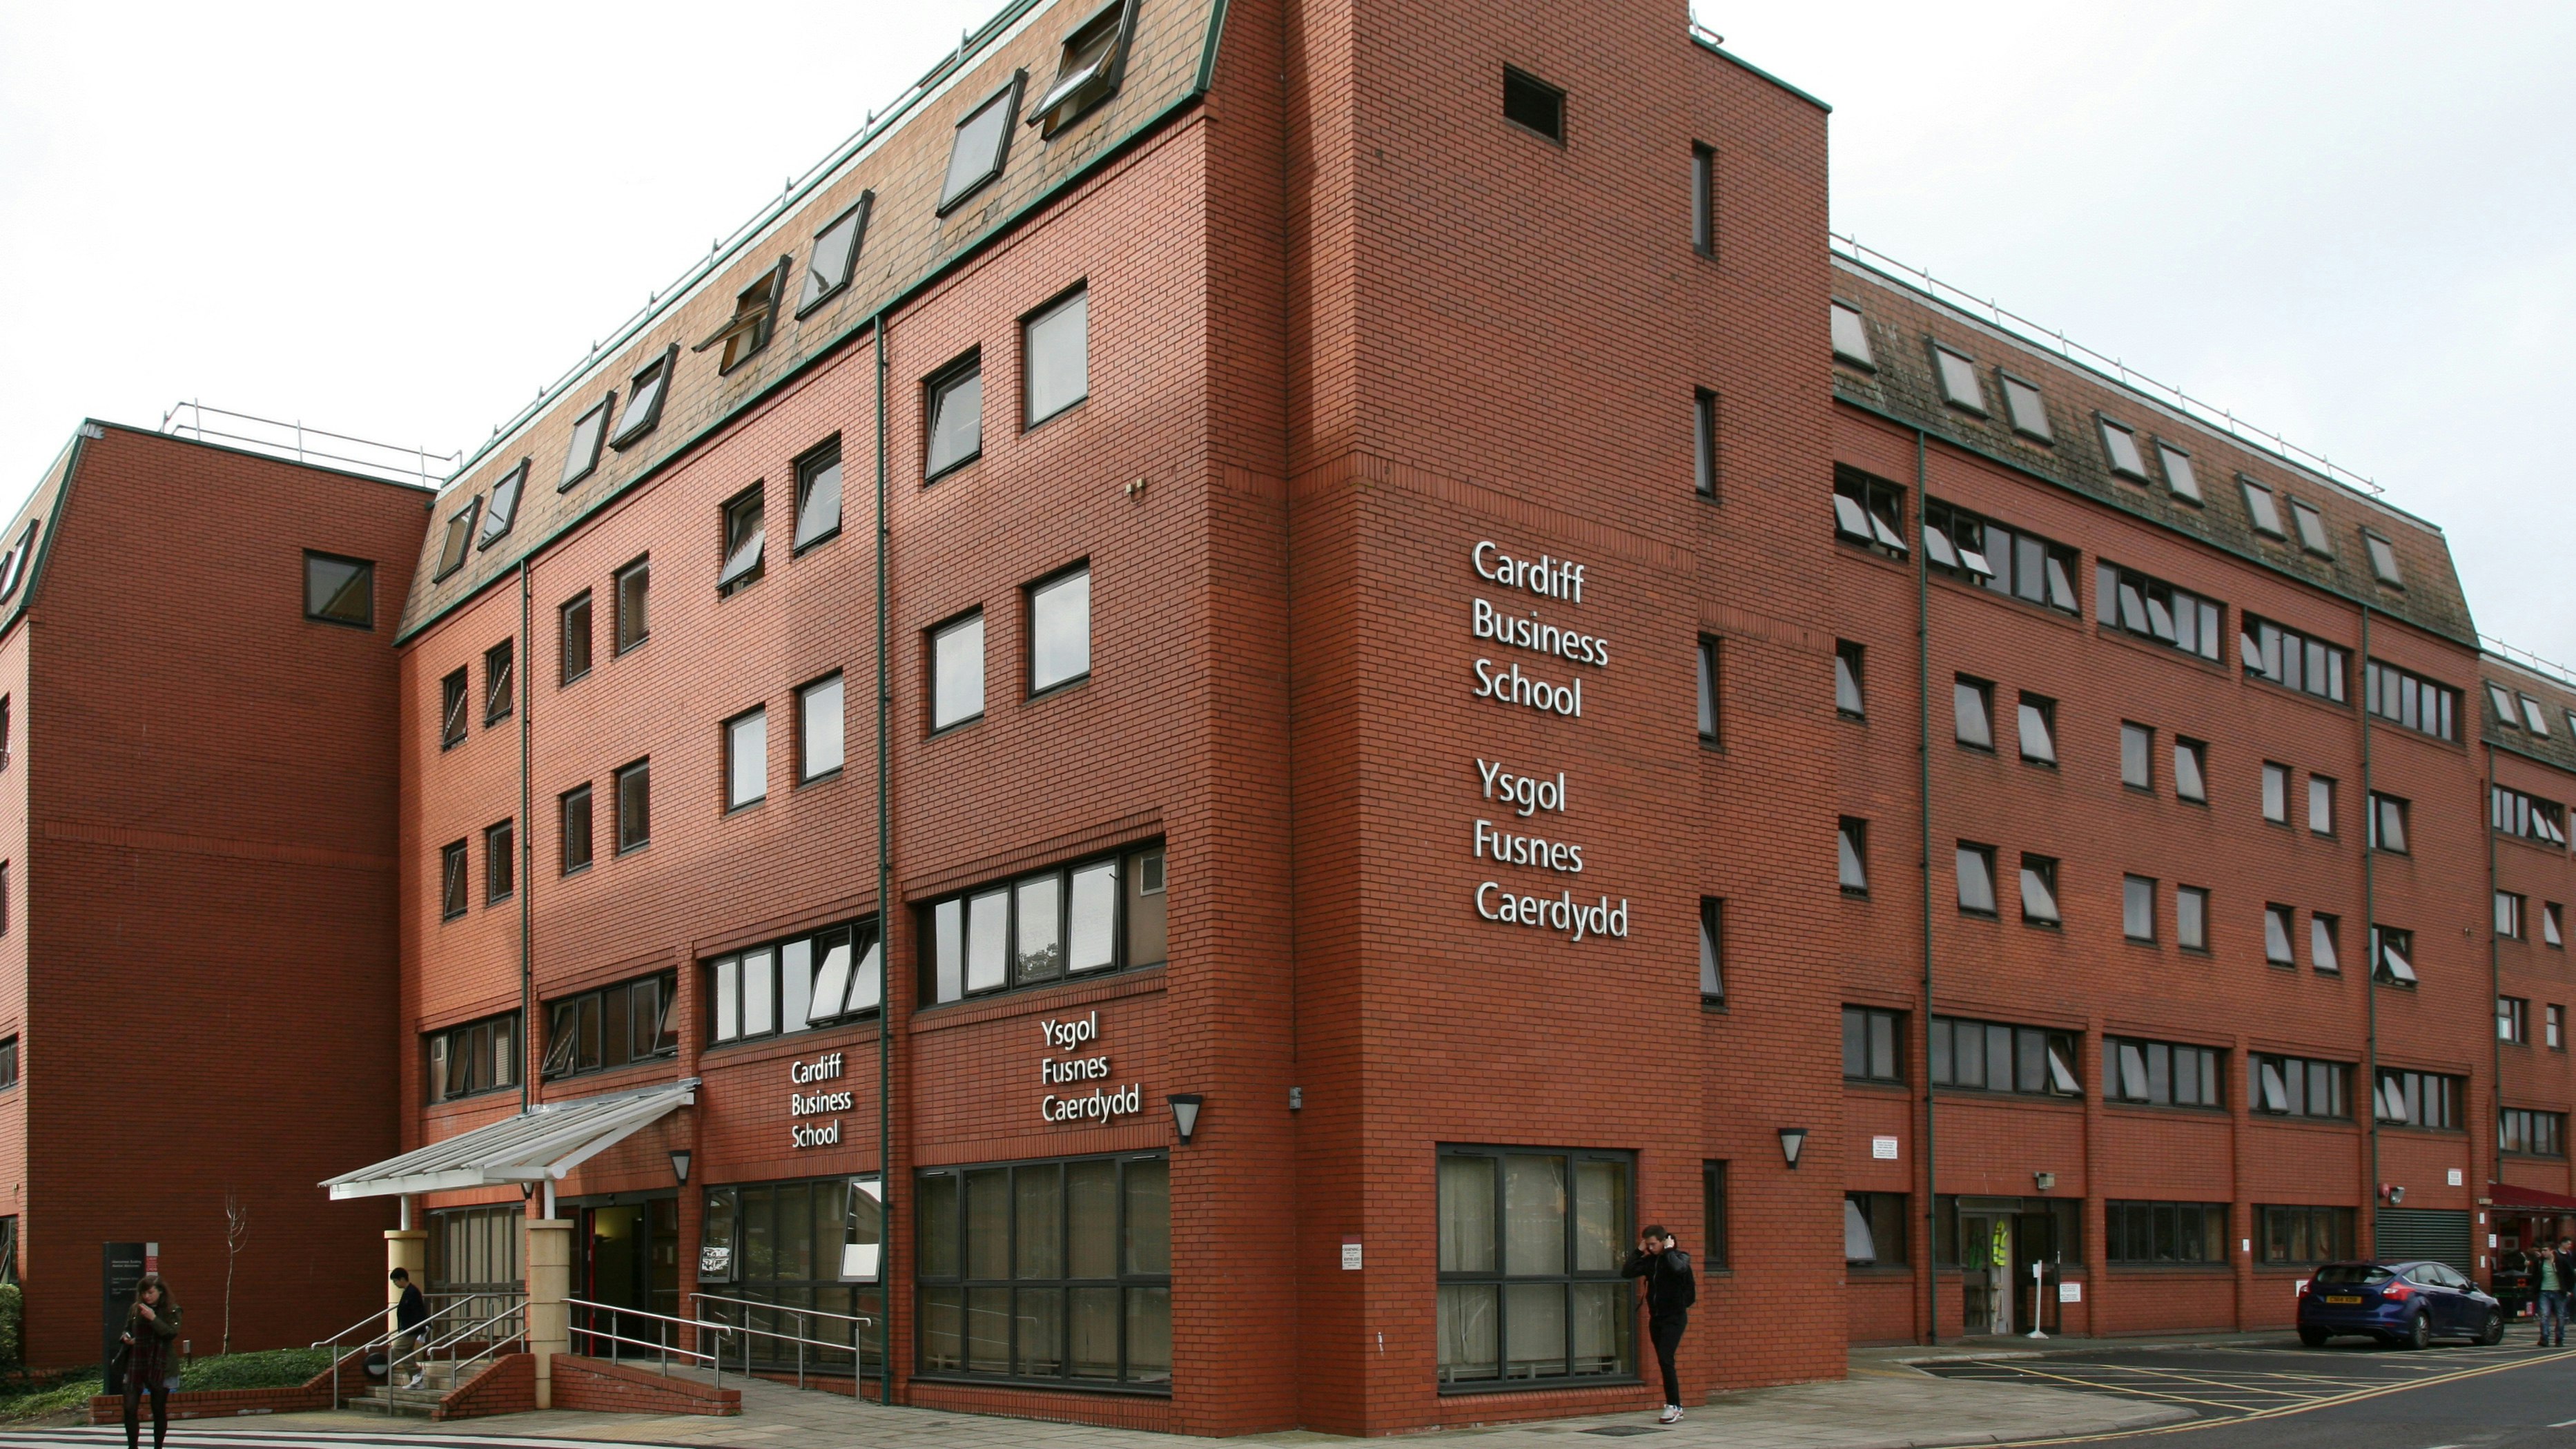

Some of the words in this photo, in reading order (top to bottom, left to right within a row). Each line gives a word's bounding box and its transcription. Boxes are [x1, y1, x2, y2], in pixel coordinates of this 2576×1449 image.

[1472, 541, 1585, 604] Cardiff
[1472, 598, 1609, 667] Business
[1473, 658, 1581, 717] School
[1476, 758, 1565, 817] Ysgol
[1474, 819, 1583, 873] Fusnes
[1474, 881, 1628, 942] Caerdydd
[1042, 1011, 1097, 1051] Ysgol
[791, 1053, 842, 1084] Cardiff
[1042, 1056, 1109, 1085] Fusnes
[792, 1089, 852, 1116] Business
[1042, 1083, 1141, 1124] Caerdydd
[792, 1119, 839, 1149] School
